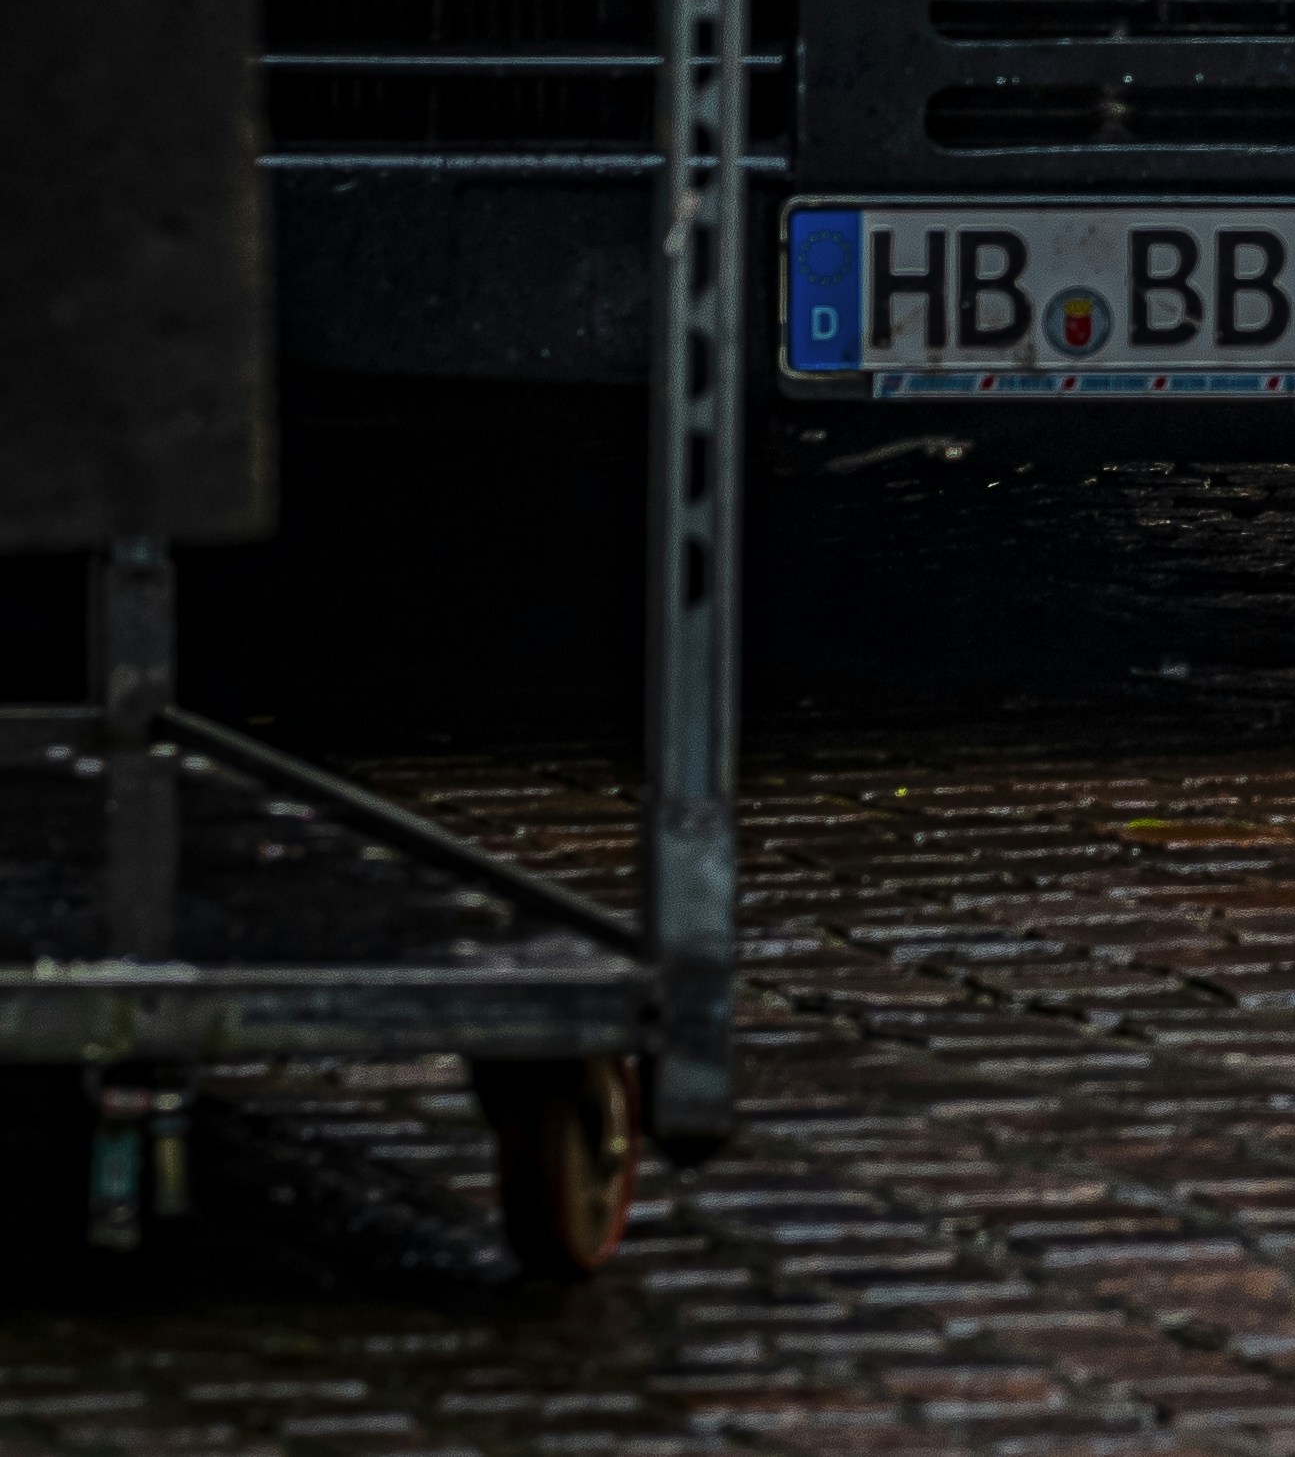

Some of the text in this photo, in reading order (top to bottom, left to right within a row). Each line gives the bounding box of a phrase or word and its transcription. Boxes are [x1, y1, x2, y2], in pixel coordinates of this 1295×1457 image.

[811, 305, 839, 342] D
[868, 226, 1032, 350] HB
[1127, 226, 1292, 350] BB
